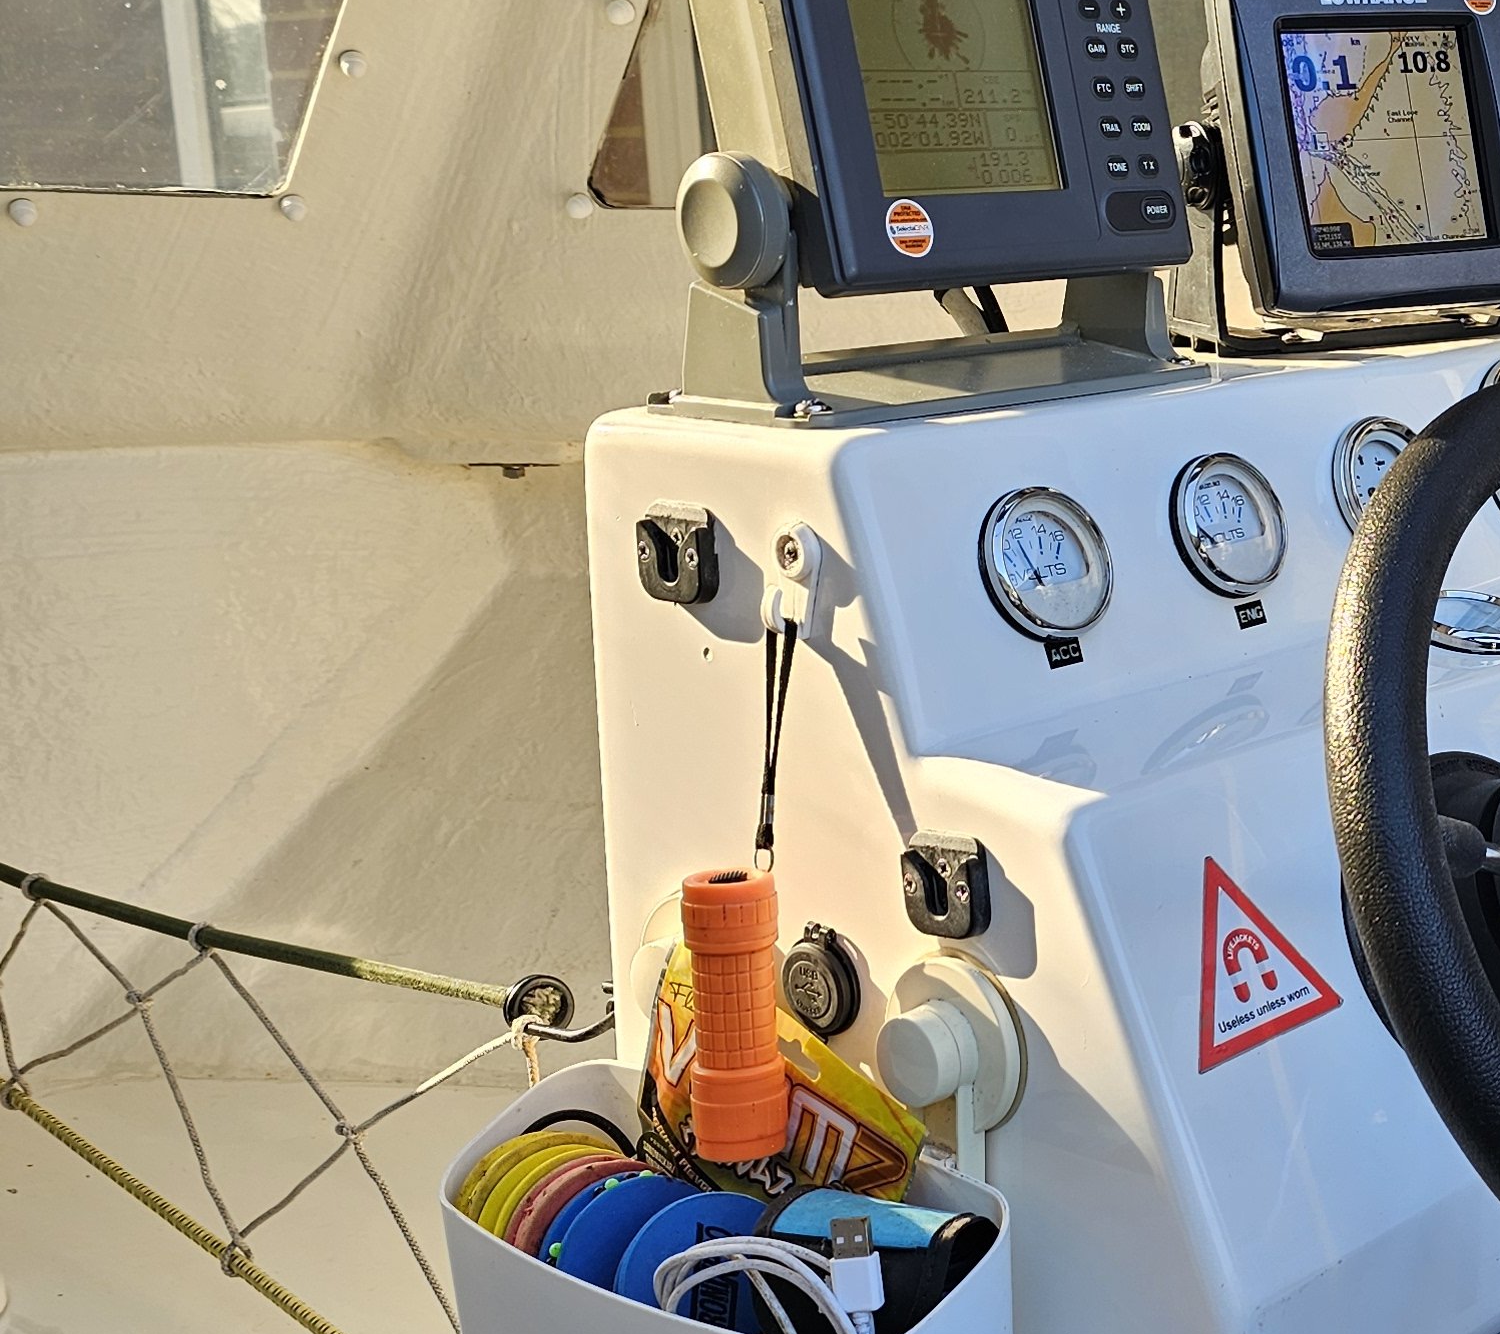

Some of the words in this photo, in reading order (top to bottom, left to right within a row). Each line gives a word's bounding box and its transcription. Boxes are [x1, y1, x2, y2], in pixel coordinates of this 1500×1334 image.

[1096, 23, 1122, 33] RANGE
[1350, 38, 1361, 46] kn
[1087, 43, 1106, 53] GAIN
[1120, 44, 1135, 53] STC
[1397, 51, 1451, 74] 10.8
[1291, 55, 1357, 93] 0.1
[1096, 83, 1112, 93] FTC
[1125, 83, 1143, 93] SHIFT
[1102, 122, 1121, 133] TRAIL
[1132, 122, 1151, 132] ZOOM
[1108, 162, 1128, 172] TONE
[1146, 205, 1168, 215] POWER
[1196, 494, 1211, 506] 12
[1216, 489, 1230, 500] 14
[1230, 494, 1245, 506] 16
[1008, 527, 1024, 541] 12
[1031, 523, 1047, 536] 14
[1049, 530, 1065, 543] 16
[1015, 563, 1067, 582] VOLTS
[1238, 605, 1263, 624] ENG
[1051, 643, 1080, 662] ACC
[1218, 1009, 1256, 1034] Useless
[1256, 997, 1287, 1019] unless
[1286, 985, 1311, 1003] worn
